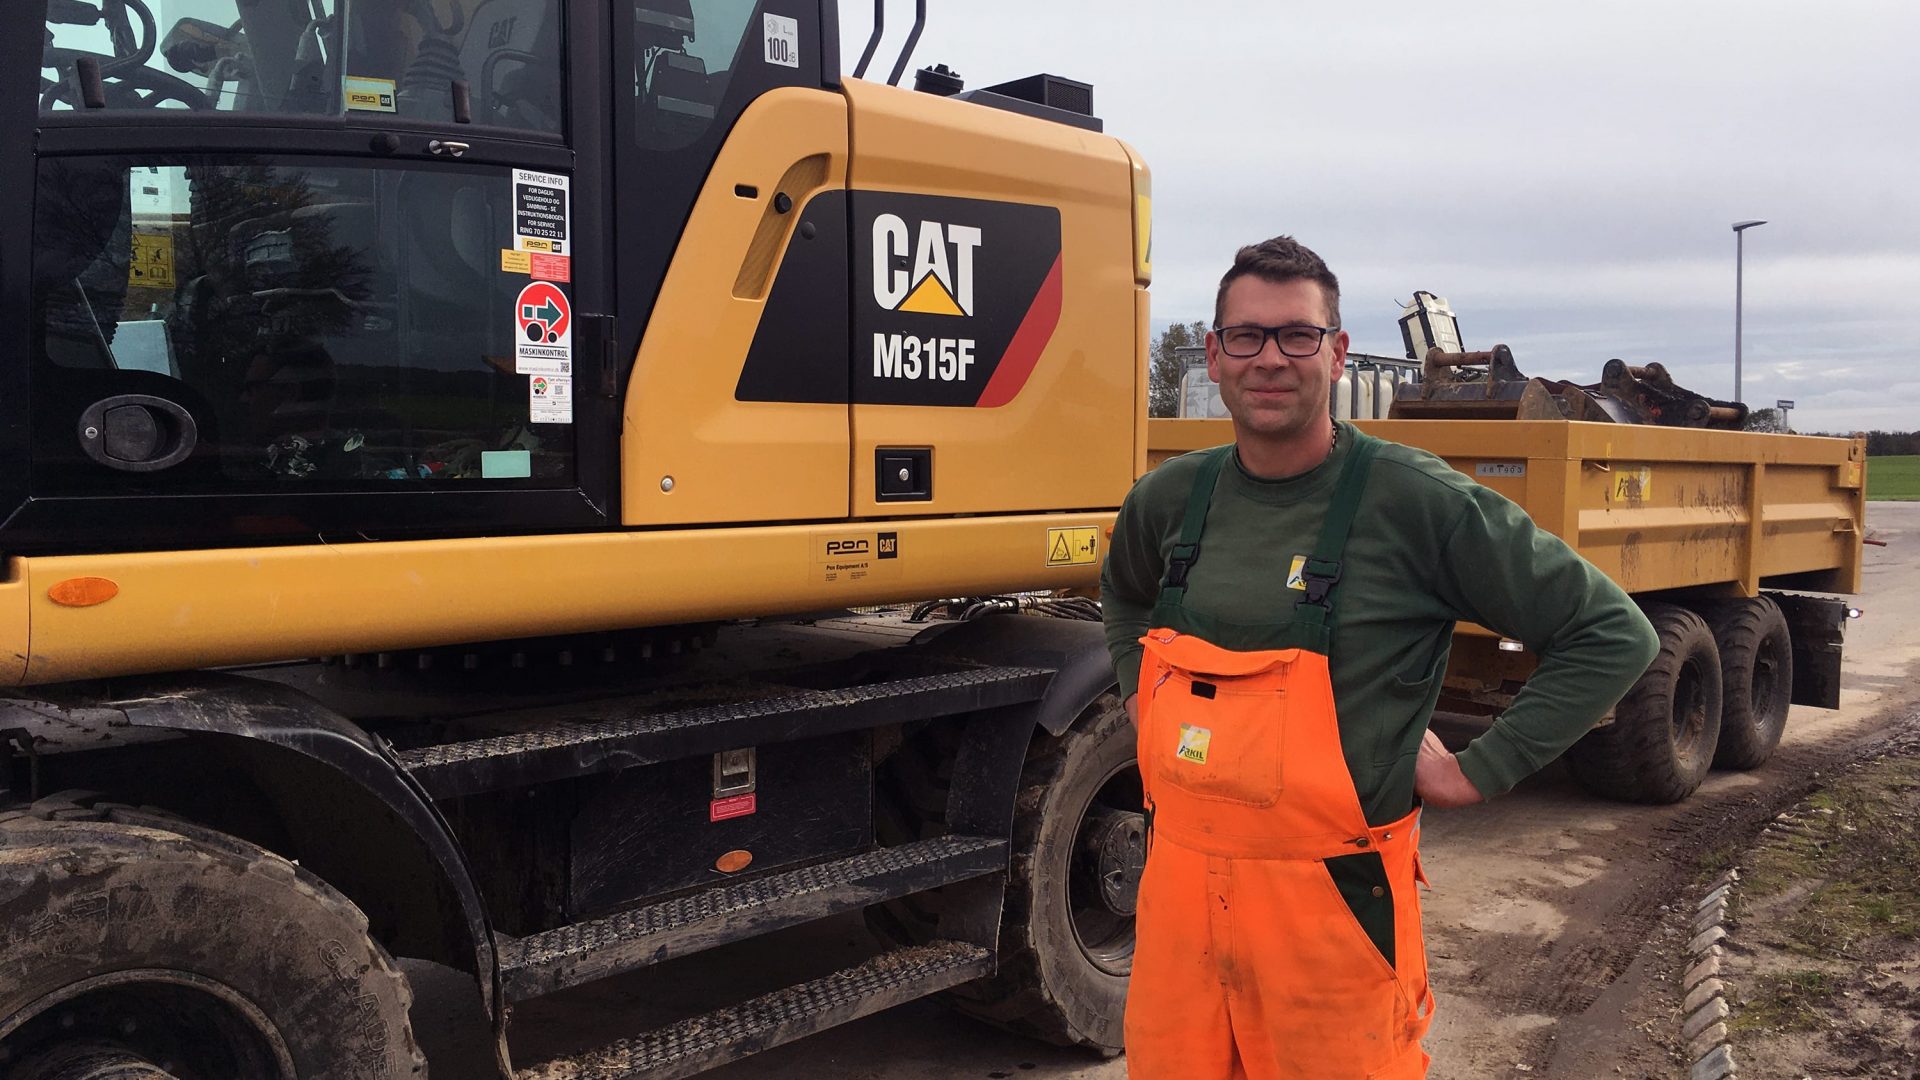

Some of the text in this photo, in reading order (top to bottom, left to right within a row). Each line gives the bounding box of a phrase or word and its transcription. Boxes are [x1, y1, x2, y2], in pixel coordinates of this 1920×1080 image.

[767, 36, 788, 62] 100
[519, 172, 563, 186] SERVICE INFO
[523, 194, 552, 203] VEDLIGEHOLD
[537, 220, 556, 229] SERVICE
[519, 226, 533, 235] RING
[549, 230, 556, 238] 22
[557, 231, 563, 239] 11
[872, 213, 982, 317] CAT
[519, 346, 568, 358] MASKINKONTROL
[873, 332, 976, 382] M315F
[879, 538, 896, 553] CAT
